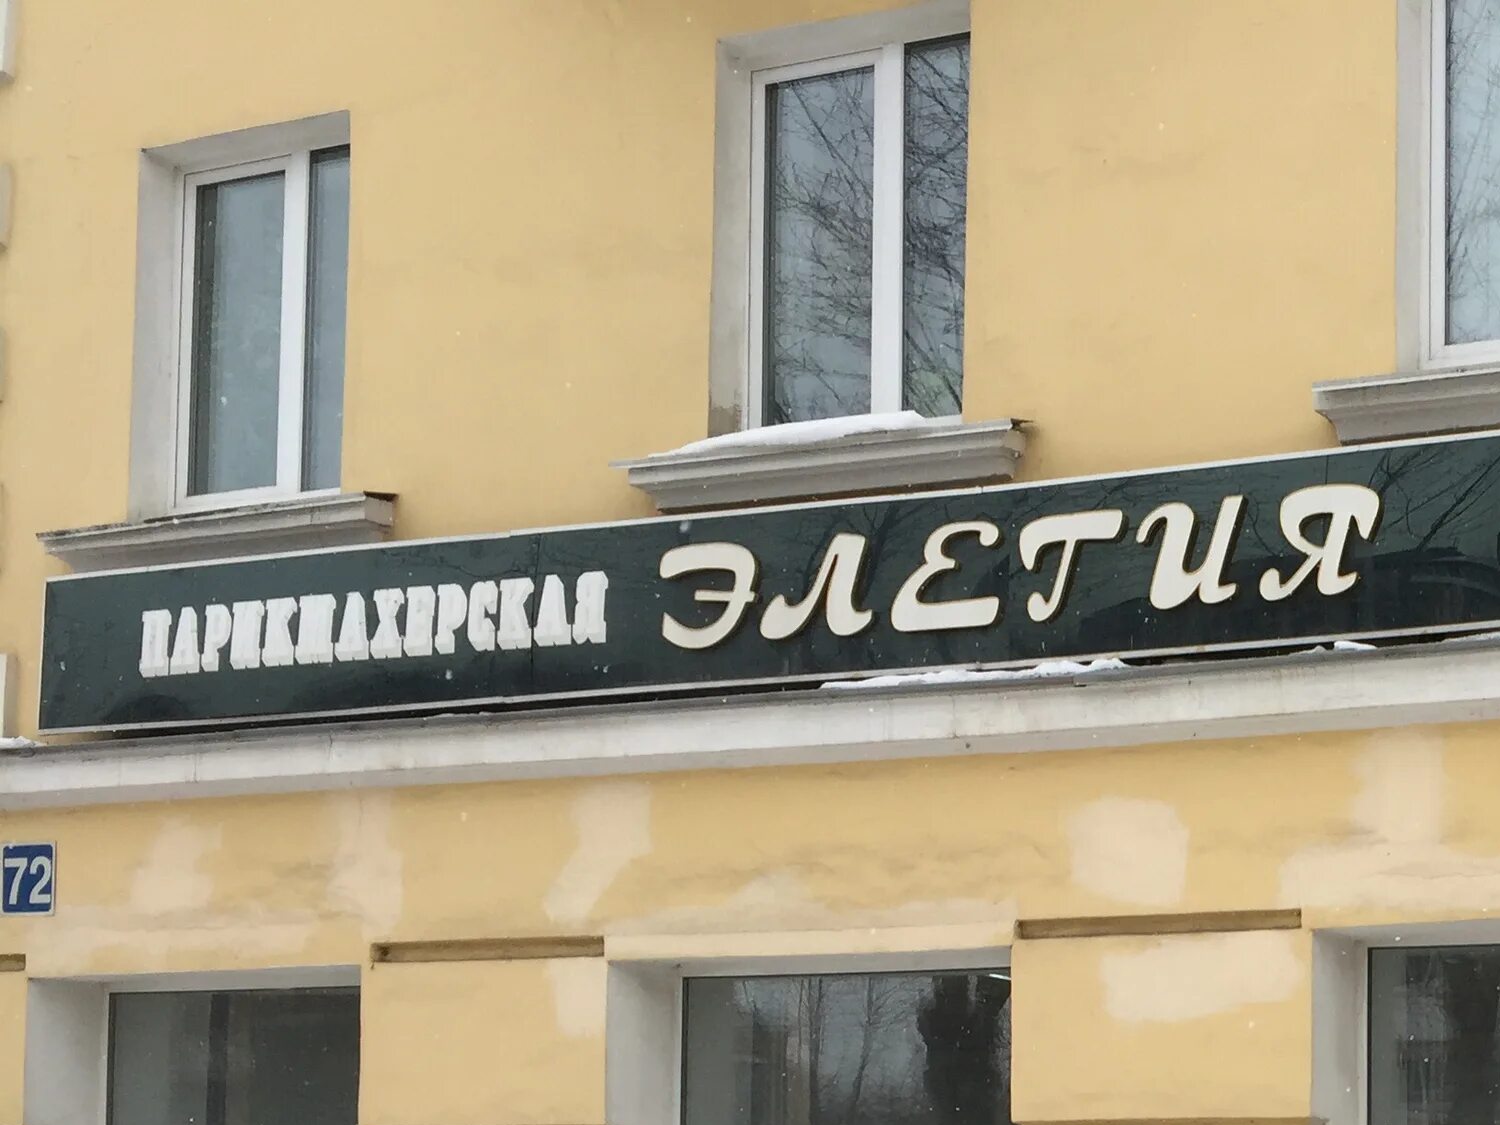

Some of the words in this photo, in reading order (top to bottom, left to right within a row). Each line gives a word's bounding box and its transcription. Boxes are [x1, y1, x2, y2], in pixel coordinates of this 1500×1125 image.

[139, 570, 609, 679] ПАРИКМАХЕРСКАЯ
[659, 483, 1380, 650] ЭЛЕГИЯ
[4, 856, 52, 905] 72
